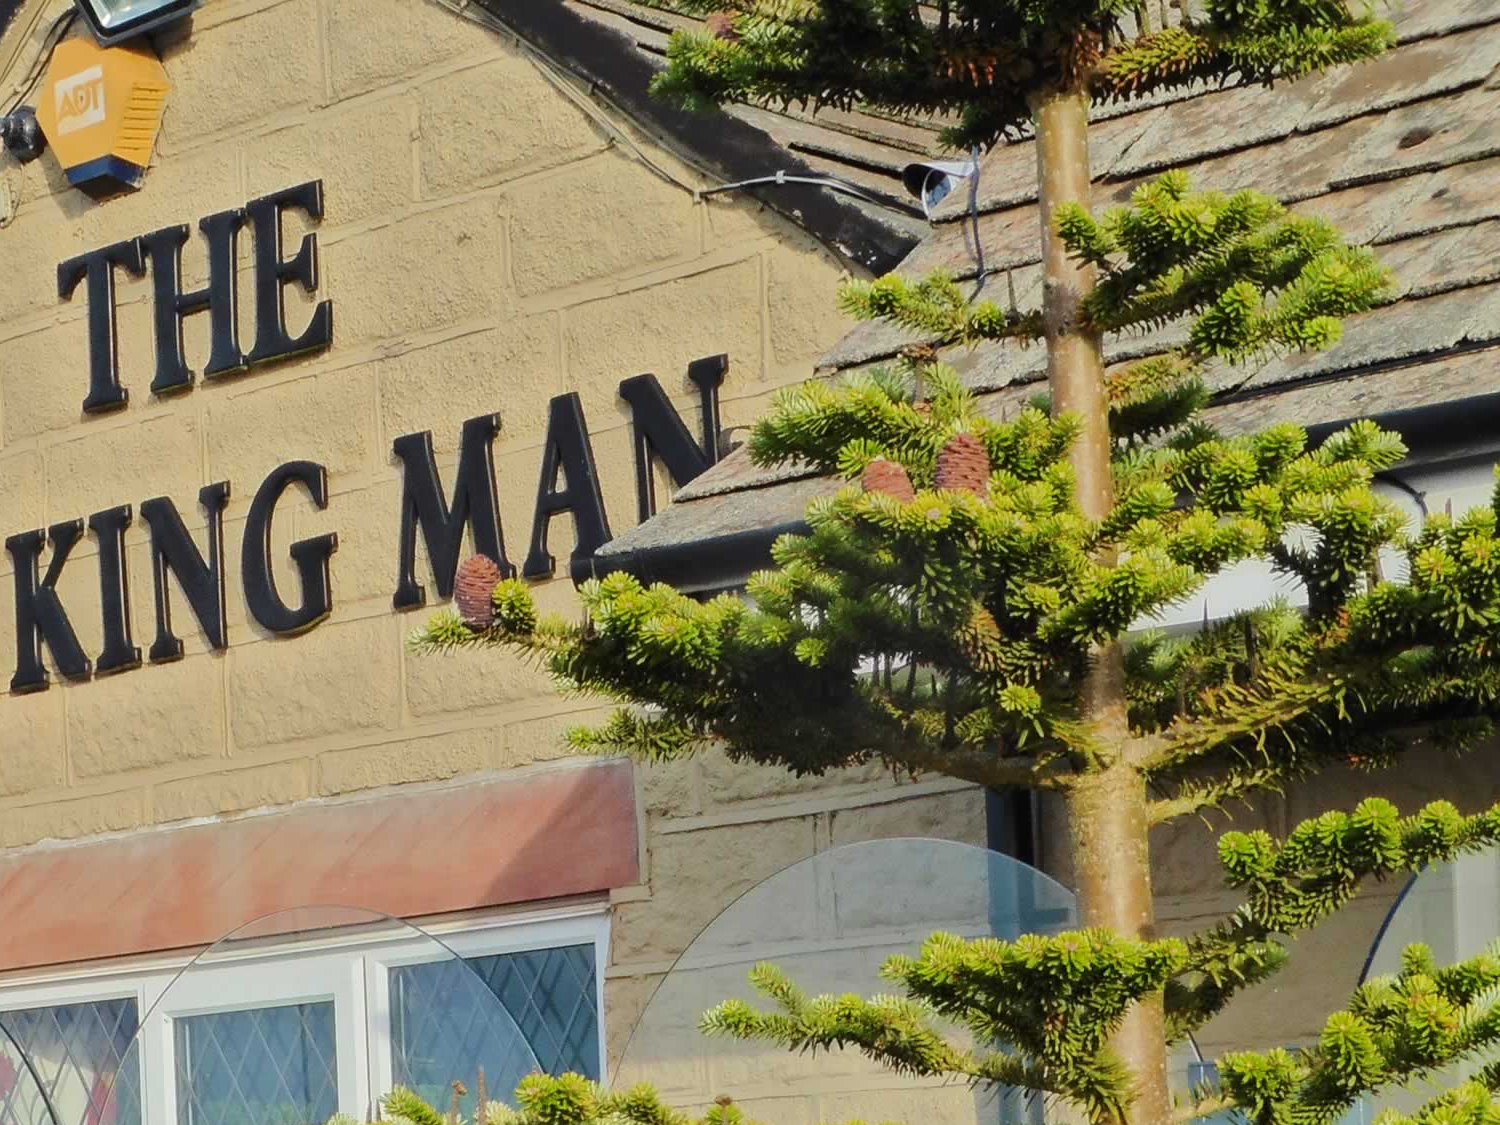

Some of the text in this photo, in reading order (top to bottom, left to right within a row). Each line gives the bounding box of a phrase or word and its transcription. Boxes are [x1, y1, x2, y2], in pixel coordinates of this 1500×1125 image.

[59, 79, 102, 117] ADT
[57, 179, 333, 414] THE
[389, 354, 731, 610] MAN
